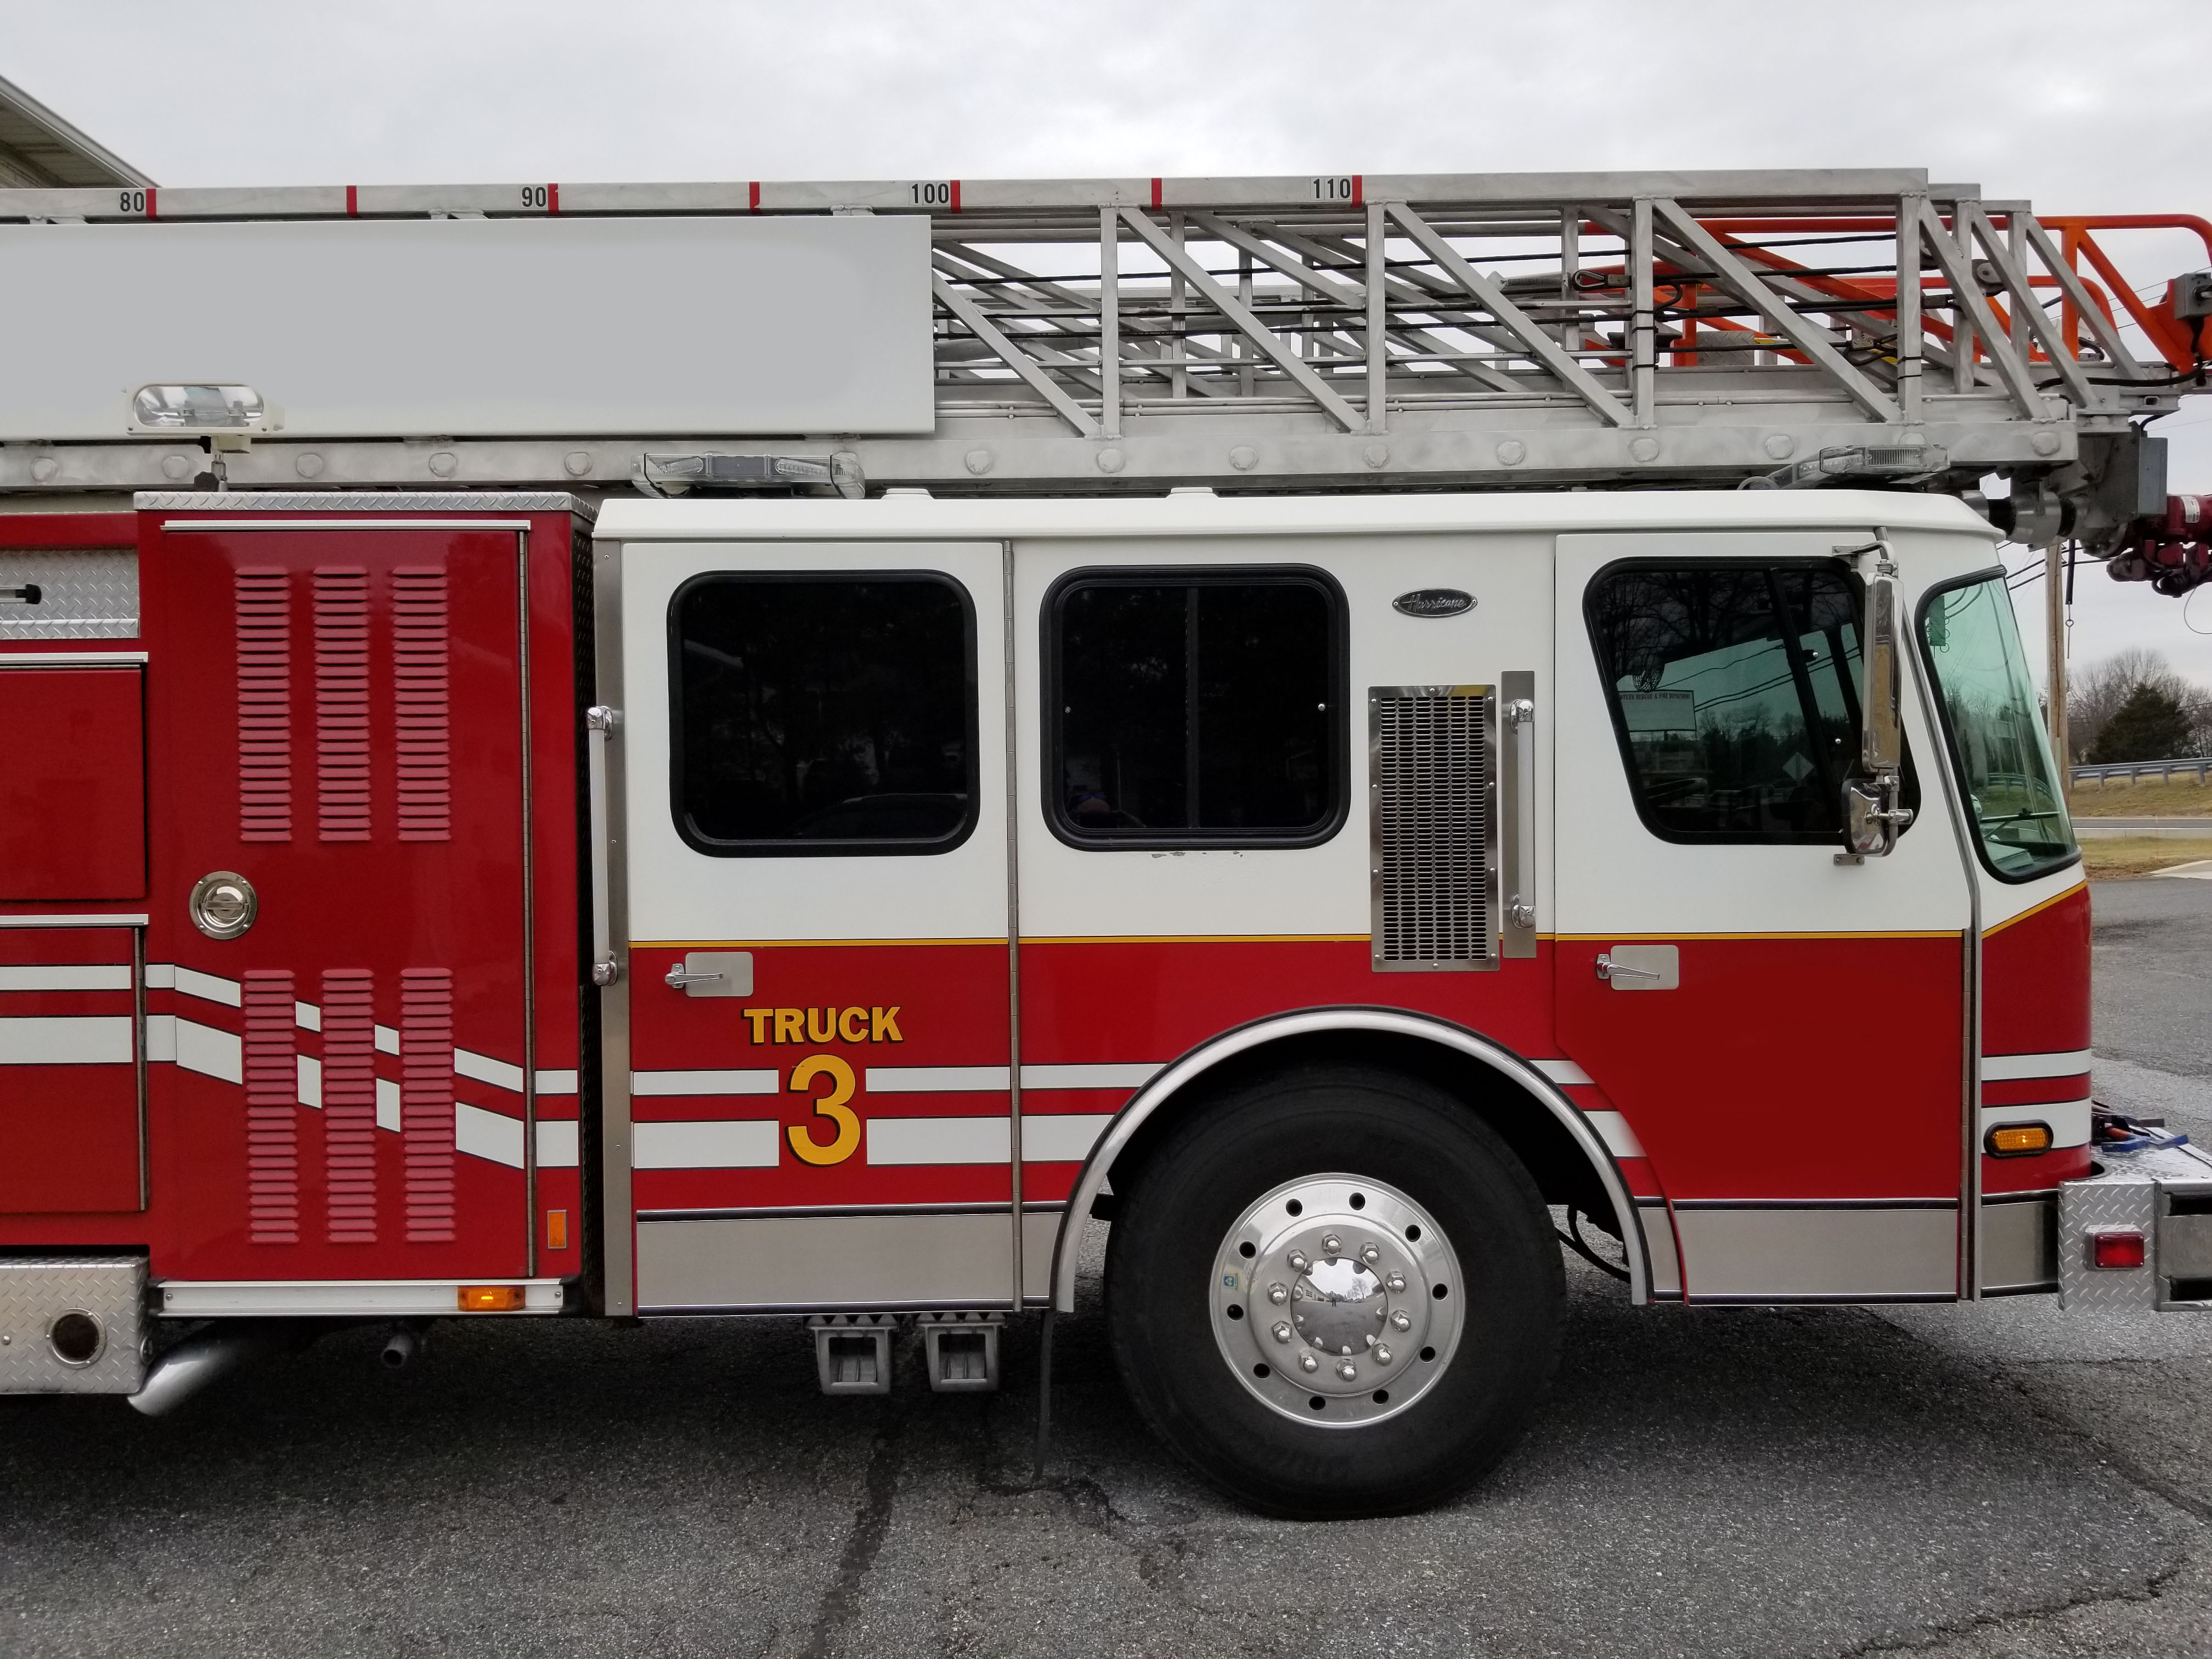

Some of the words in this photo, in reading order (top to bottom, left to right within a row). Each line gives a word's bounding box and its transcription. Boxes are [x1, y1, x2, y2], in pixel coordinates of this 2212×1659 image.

[521, 187, 546, 207] 90
[911, 183, 949, 204] 100
[1313, 178, 1351, 199] 110
[120, 191, 145, 212] 80
[1402, 594, 1466, 613] Hurricane
[741, 1007, 903, 1046] TRUCK
[785, 1053, 861, 1167] 3
